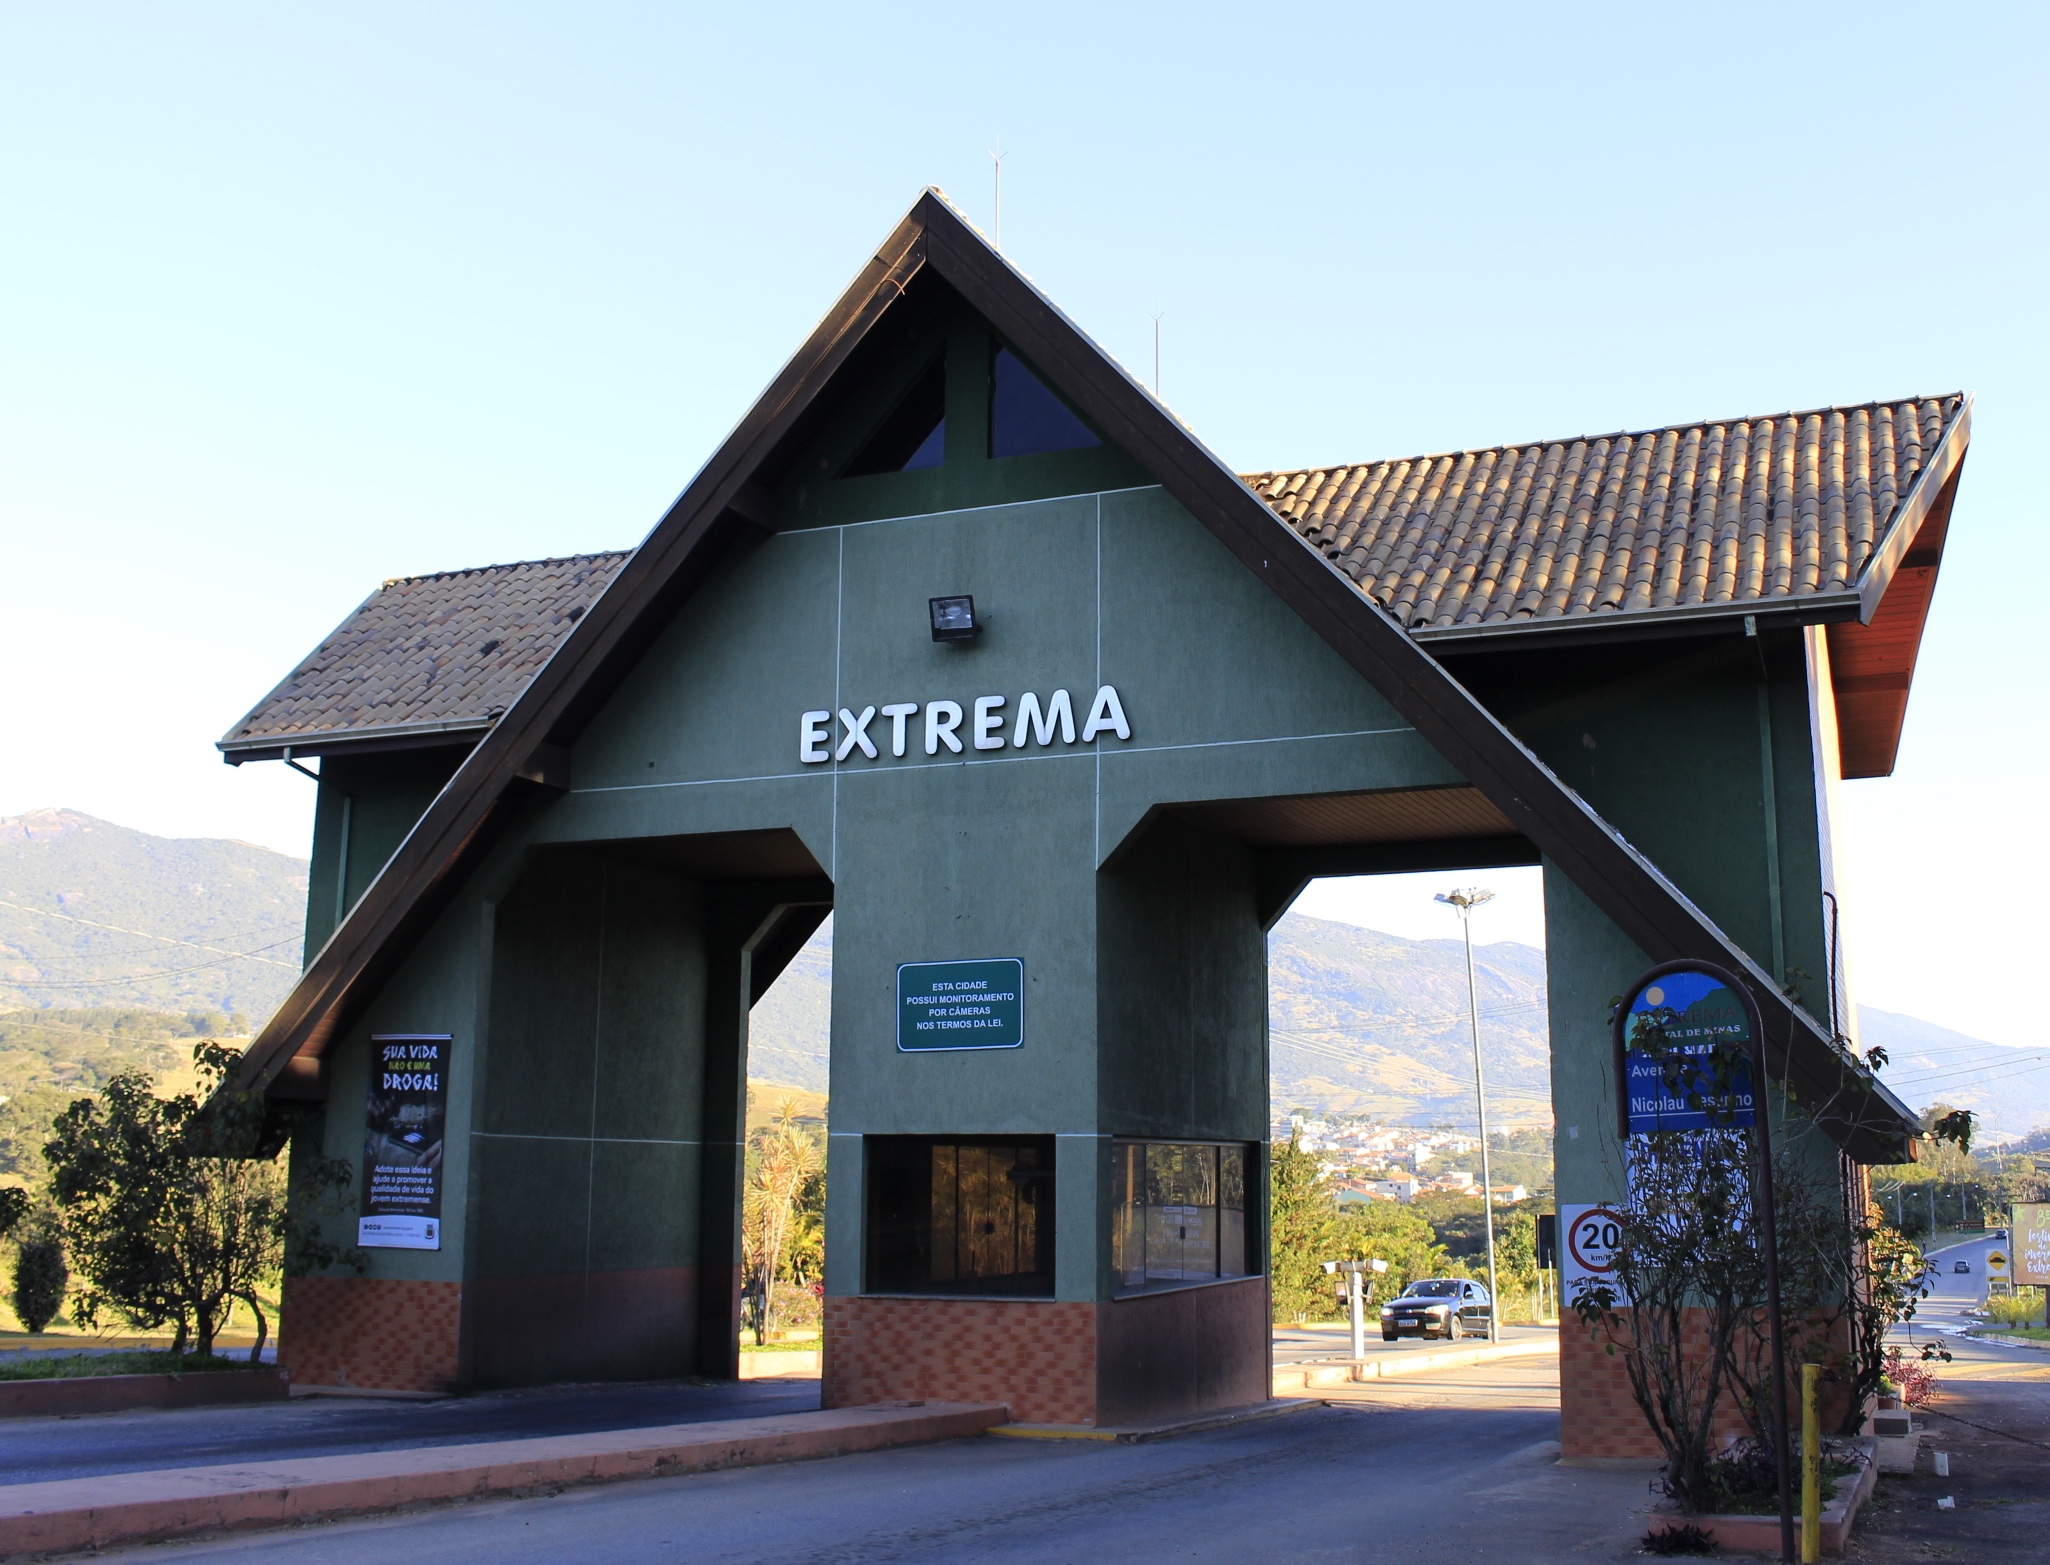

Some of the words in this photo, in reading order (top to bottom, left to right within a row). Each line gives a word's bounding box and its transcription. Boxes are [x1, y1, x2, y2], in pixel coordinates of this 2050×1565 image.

[800, 685, 1131, 763] EXTREMA
[932, 982, 954, 991] ESTA
[955, 981, 988, 990] CIDADE
[906, 996, 938, 1005] POSSUI
[939, 993, 1014, 1003] MONITORAMENTO
[928, 1008, 947, 1017] POR
[948, 1006, 991, 1016] CÂMERAS
[916, 1021, 935, 1030] NOS
[936, 1020, 972, 1029] TERMOS
[973, 1019, 987, 1028] DA
[987, 1018, 1004, 1027] LEI.
[1686, 1028, 1701, 1037] DE
[383, 1045, 406, 1061] SUA
[409, 1045, 438, 1059] VIDA
[383, 1073, 438, 1091] DROGA!
[1632, 1096, 1684, 1112] Nicolau
[374, 1165, 394, 1173] Adote
[411, 1166, 427, 1174] ideia
[373, 1176, 391, 1185] ajude
[396, 1177, 427, 1185] promover
[371, 1185, 401, 1194] qualidade
[401, 1185, 410, 1193] de
[425, 1186, 435, 1194] do
[370, 1195, 391, 1204] jovem
[1582, 1223, 1620, 1250] 20
[2038, 1241, 2047, 1251] de
